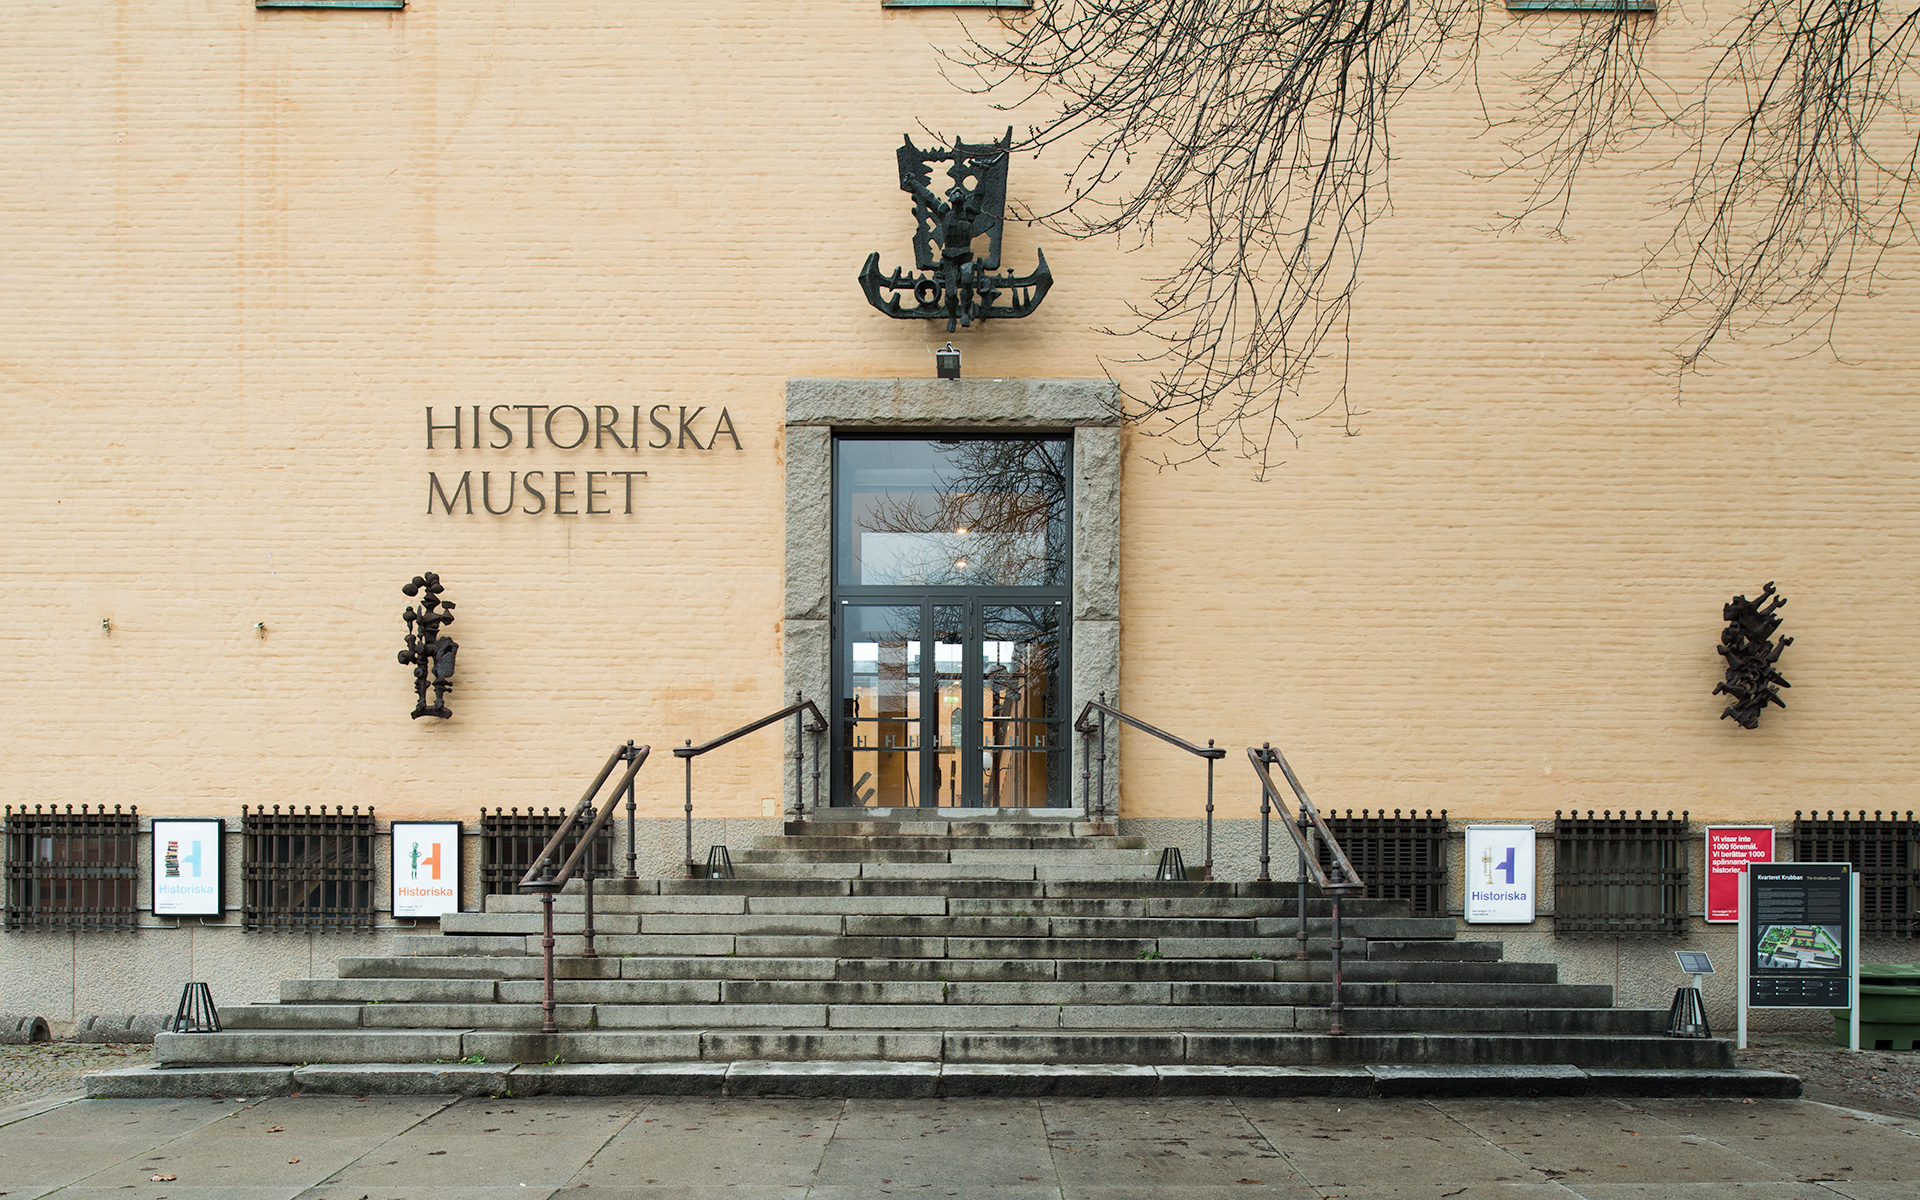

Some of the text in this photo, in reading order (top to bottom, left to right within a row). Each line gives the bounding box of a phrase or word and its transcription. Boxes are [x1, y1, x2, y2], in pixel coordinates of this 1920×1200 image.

[426, 405, 743, 450] HISTORISKA
[426, 470, 648, 515] MUSEET
[159, 884, 213, 894] Historiska
[399, 887, 453, 896] Historiska
[1472, 892, 1526, 901] Historiska
